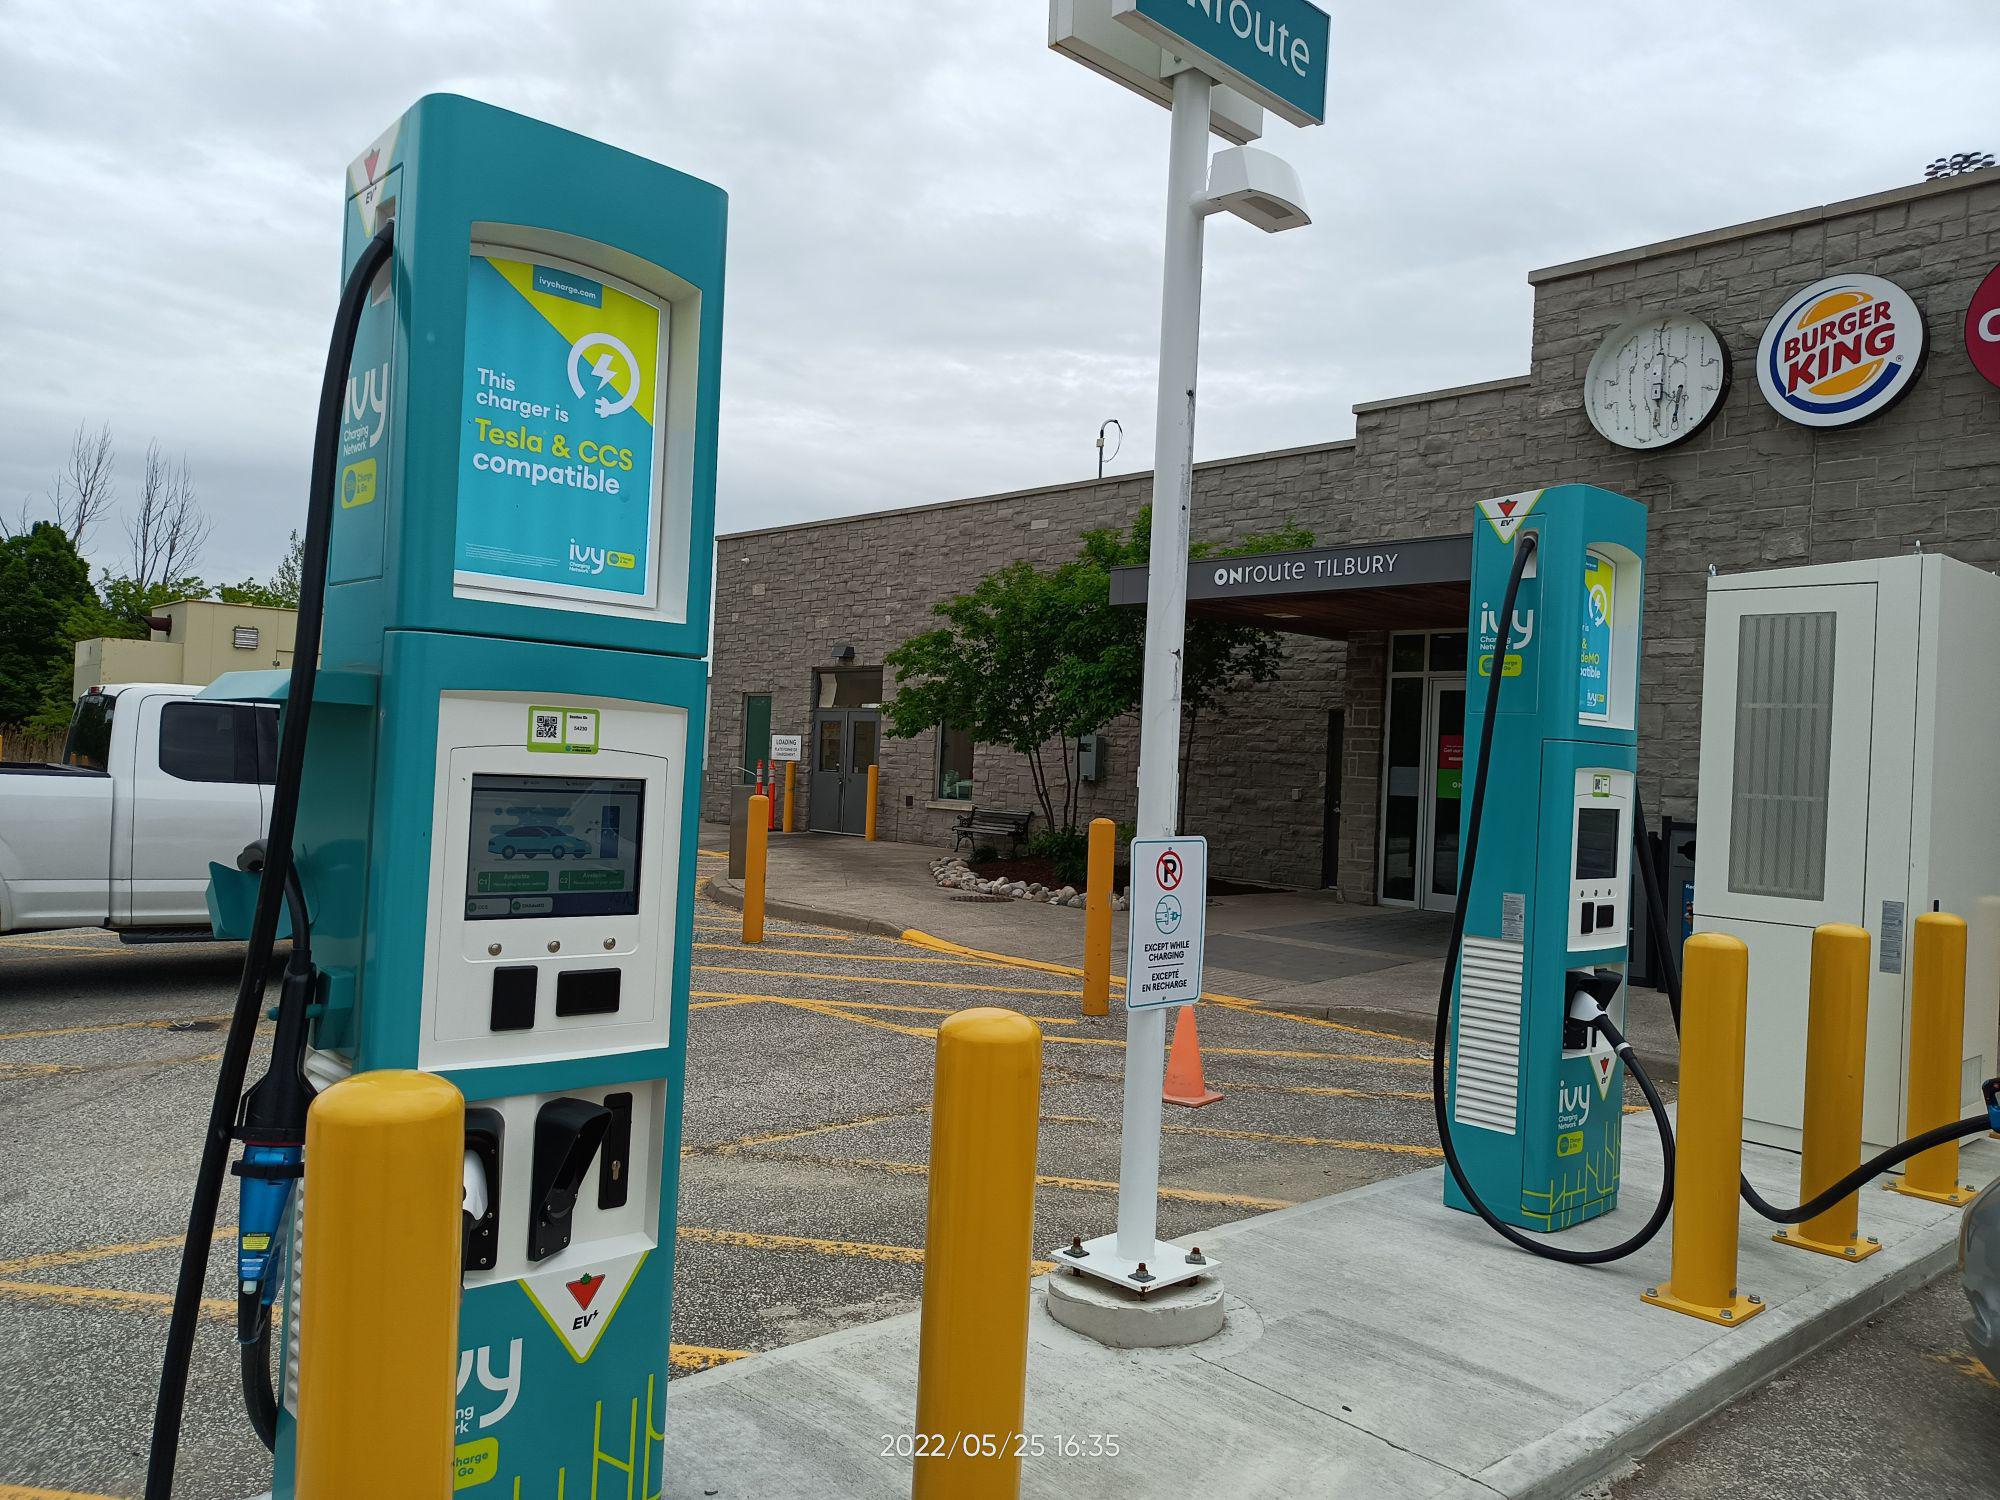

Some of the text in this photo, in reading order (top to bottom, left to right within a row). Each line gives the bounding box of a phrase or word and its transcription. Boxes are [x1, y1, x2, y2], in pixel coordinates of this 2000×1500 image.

[539, 275, 597, 300] ivycharge.com
[1784, 301, 1891, 363] BURGER
[1787, 322, 1895, 394] KING
[477, 367, 516, 392] This
[475, 388, 569, 423] charger is
[343, 424, 369, 442] Charging
[343, 440, 367, 457] Network
[474, 416, 634, 472] Tesla & CCS
[472, 452, 621, 495] compatible
[569, 538, 605, 575] ivy
[1213, 553, 1399, 586] ONroute TILBURY
[1580, 653, 1600, 665] deMO
[1144, 940, 1190, 953] EXCEPT WHILE
[1148, 950, 1185, 962] CHARGING
[1151, 968, 1179, 982] EXCEPTÉ
[1142, 979, 1188, 993] EN RECHARGE
[1559, 1080, 1590, 1126] ivy
[572, 1313, 594, 1330] EV
[454, 1452, 489, 1467] harge
[458, 1467, 474, 1477] Go
